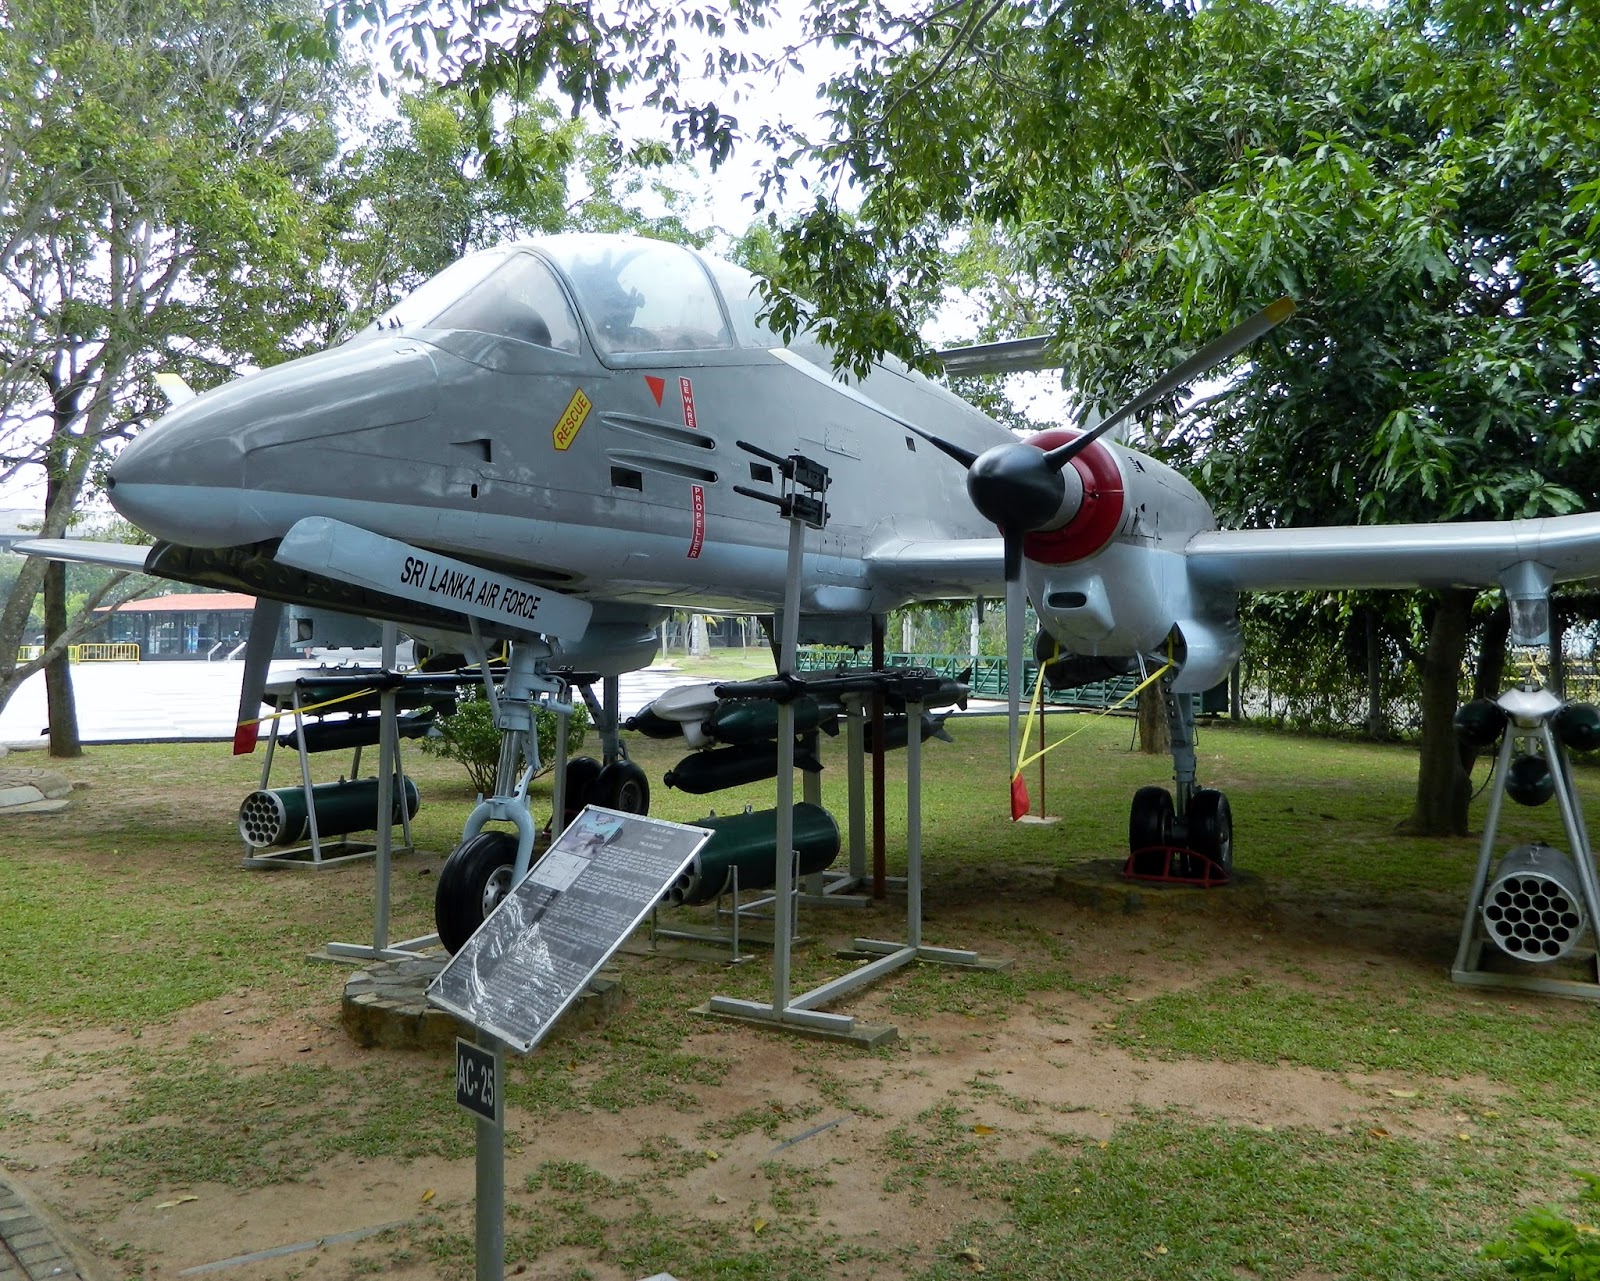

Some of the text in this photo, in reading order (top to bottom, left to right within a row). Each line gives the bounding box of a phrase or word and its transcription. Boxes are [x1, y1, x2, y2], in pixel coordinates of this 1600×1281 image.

[556, 395, 588, 445] RESCUE
[682, 379, 694, 427] BEWARE
[690, 487, 702, 558] PROPELLER
[400, 556, 541, 619] SRI LANKA AIR FORCE
[457, 1055, 494, 1107] AC-25
